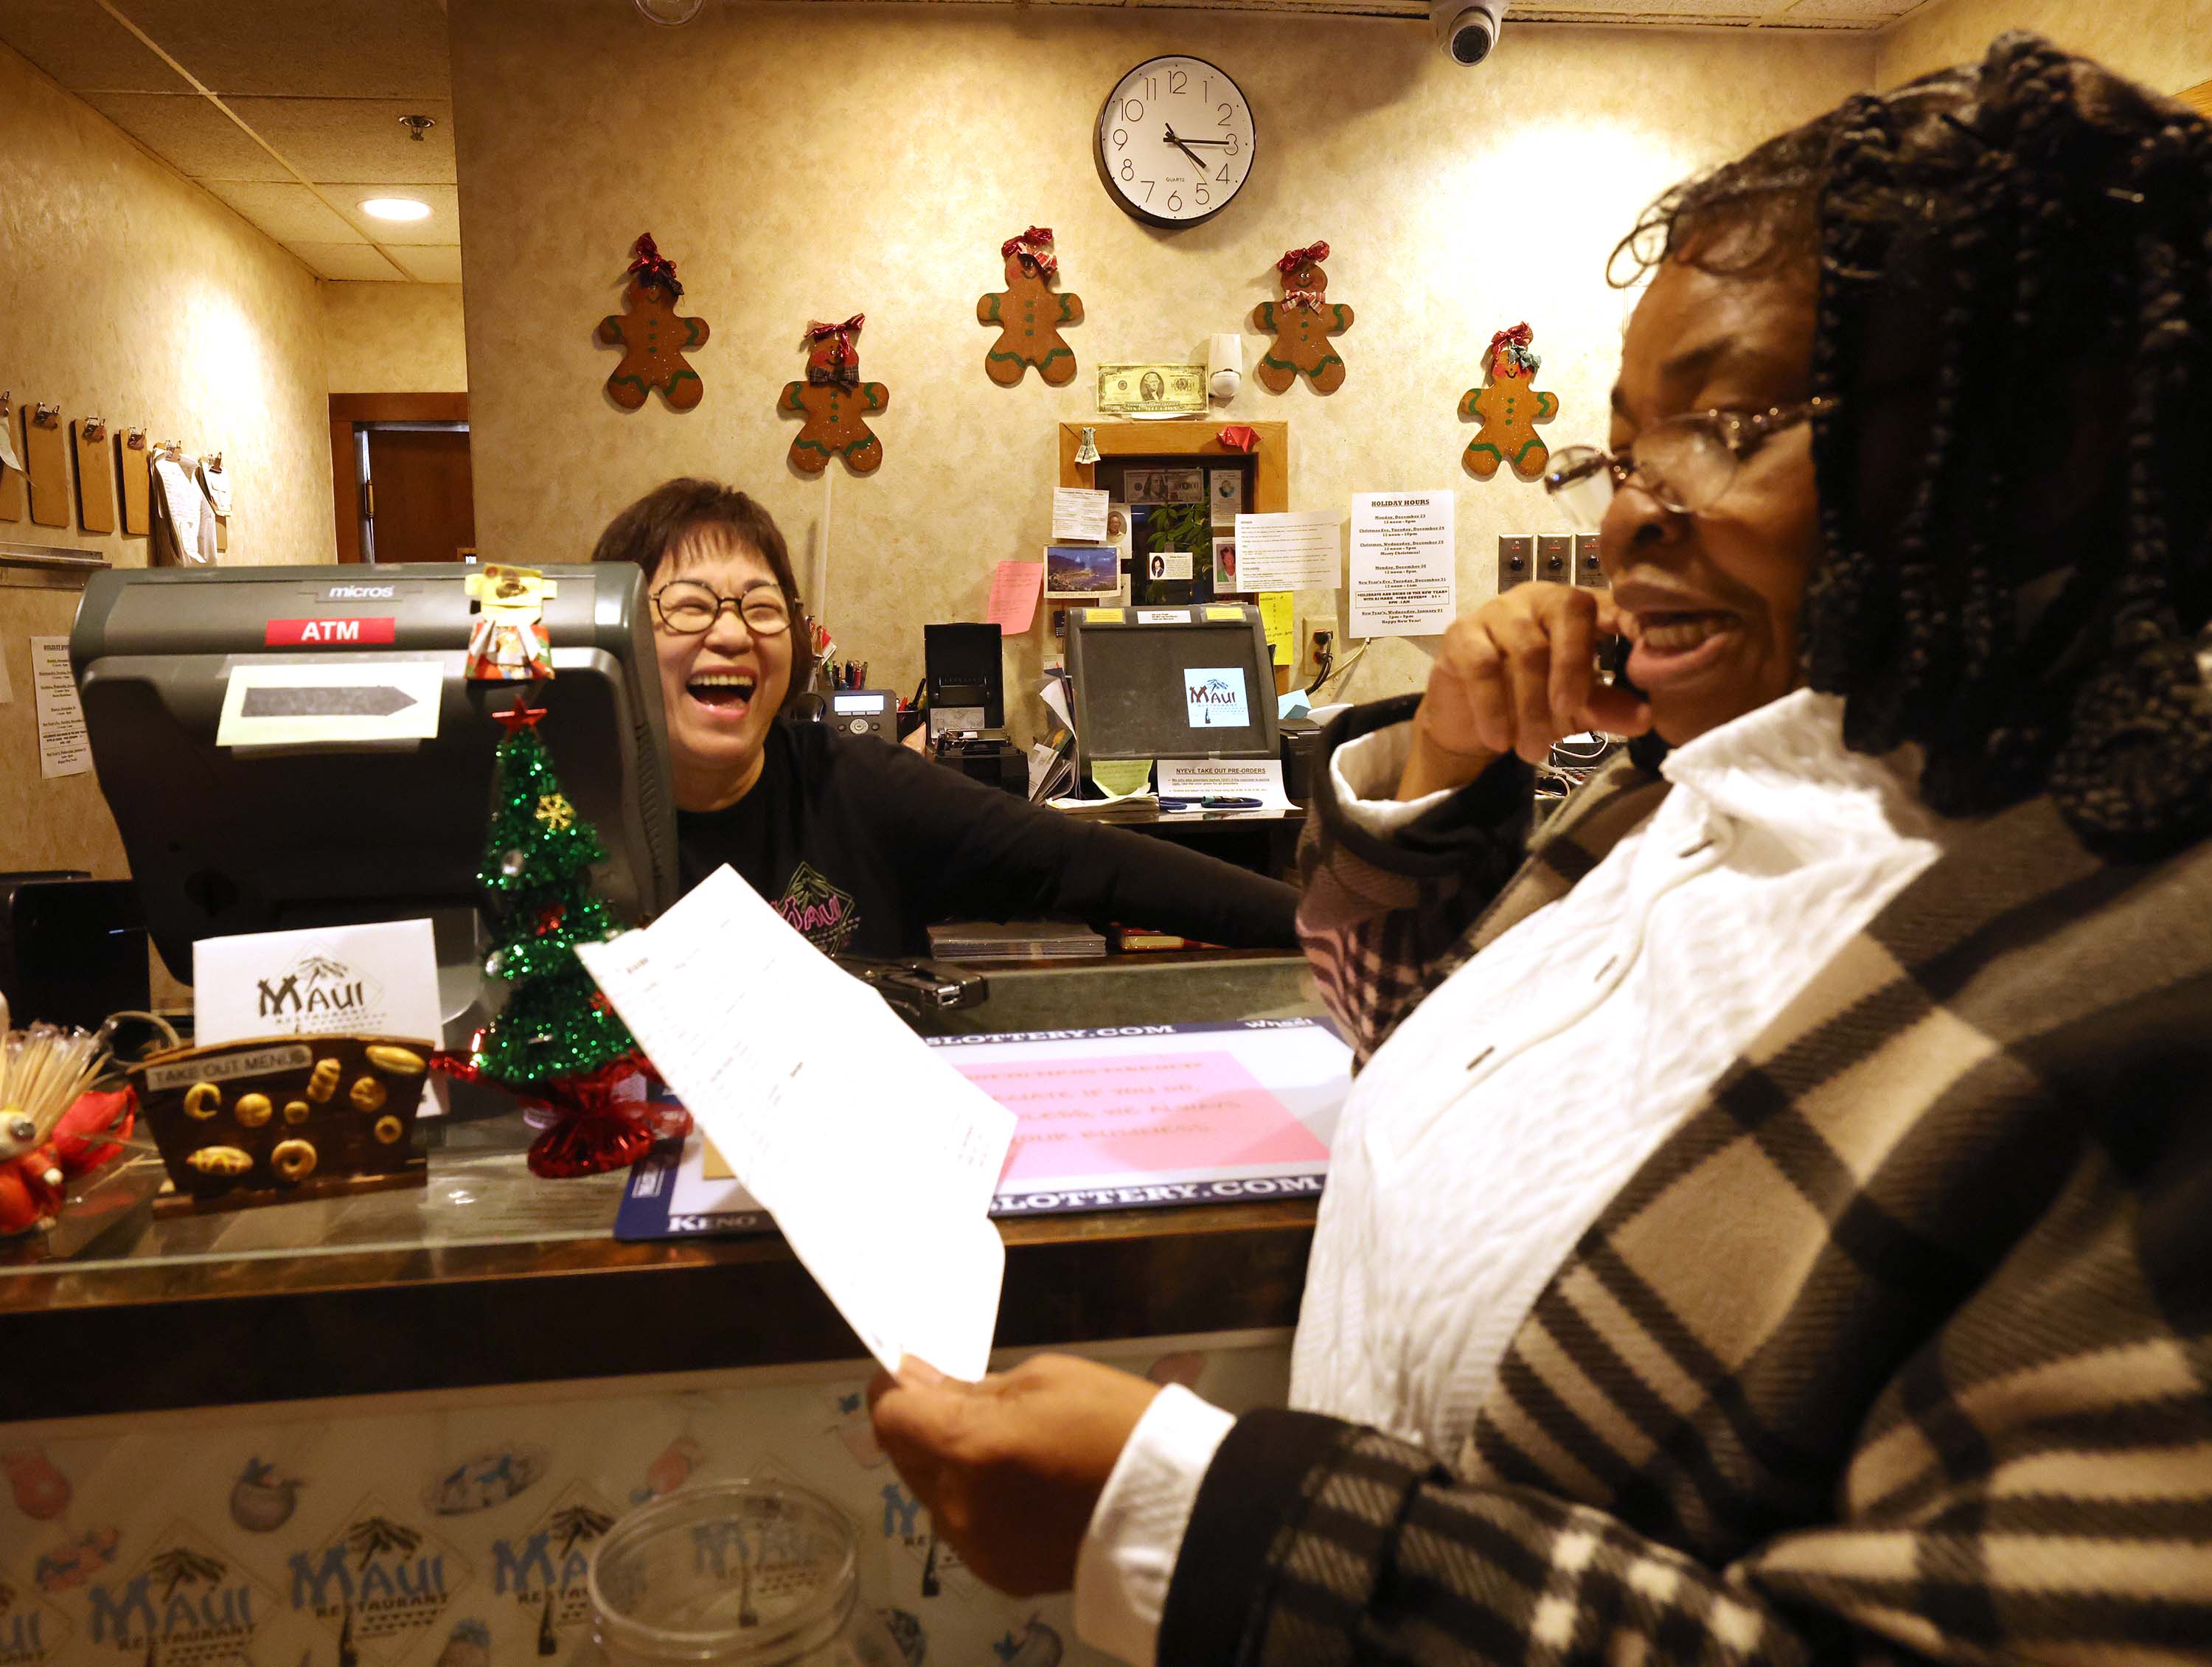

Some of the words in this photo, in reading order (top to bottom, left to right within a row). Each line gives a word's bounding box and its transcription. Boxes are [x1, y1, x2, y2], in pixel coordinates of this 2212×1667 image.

[1144, 77, 1156, 100] 11
[1167, 71, 1186, 94] 12
[1203, 80, 1207, 103] 1
[1120, 98, 1144, 122] 10
[1217, 103, 1232, 126] 2
[1113, 128, 1127, 151] 9
[1223, 133, 1238, 156] 3
[1121, 159, 1134, 181] 8
[1215, 163, 1230, 184] 4
[1141, 181, 1155, 203] 7
[1167, 189, 1182, 212] 6
[1195, 182, 1209, 205] 5
[330, 585, 393, 598] micros
[301, 620, 359, 641] ATM
[257, 974, 363, 1017] MAUI
[153, 1065, 198, 1083] TAKE
[203, 1058, 238, 1077] OUT
[667, 1215, 759, 1233] KENO
[291, 1545, 445, 1609] MAUI
[89, 1575, 251, 1645] MAUI
